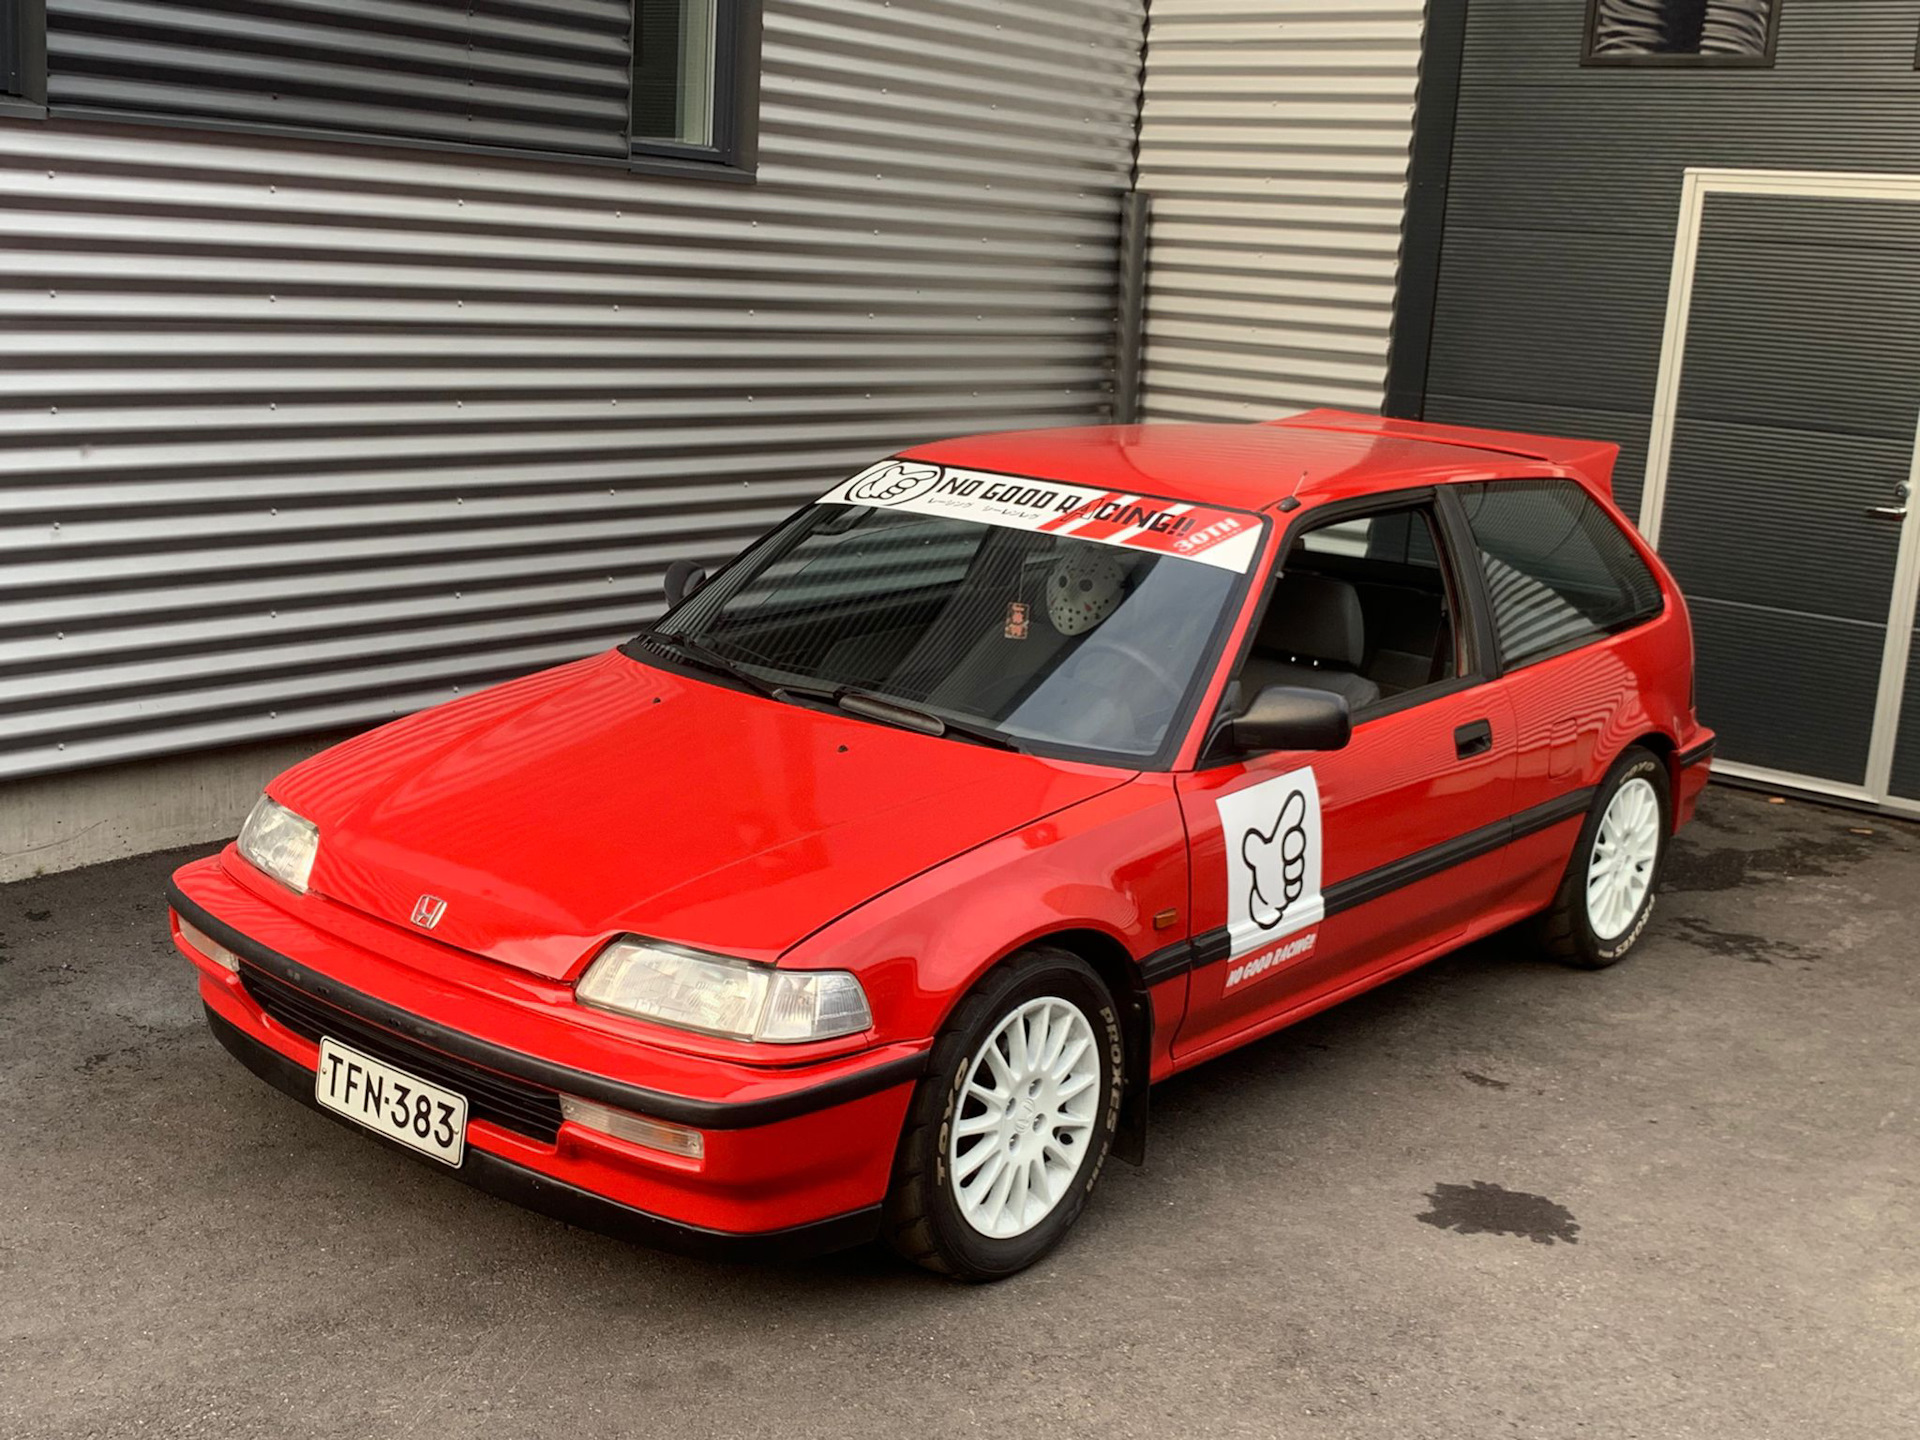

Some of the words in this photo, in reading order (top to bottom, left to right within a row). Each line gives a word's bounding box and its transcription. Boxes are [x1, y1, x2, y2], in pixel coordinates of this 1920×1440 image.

[936, 477, 984, 497] NO
[978, 483, 1059, 509] GOOD
[1053, 495, 1196, 537] RACING!!
[1173, 517, 1241, 552] 30TH
[1100, 1006, 1122, 1132] PROXES
